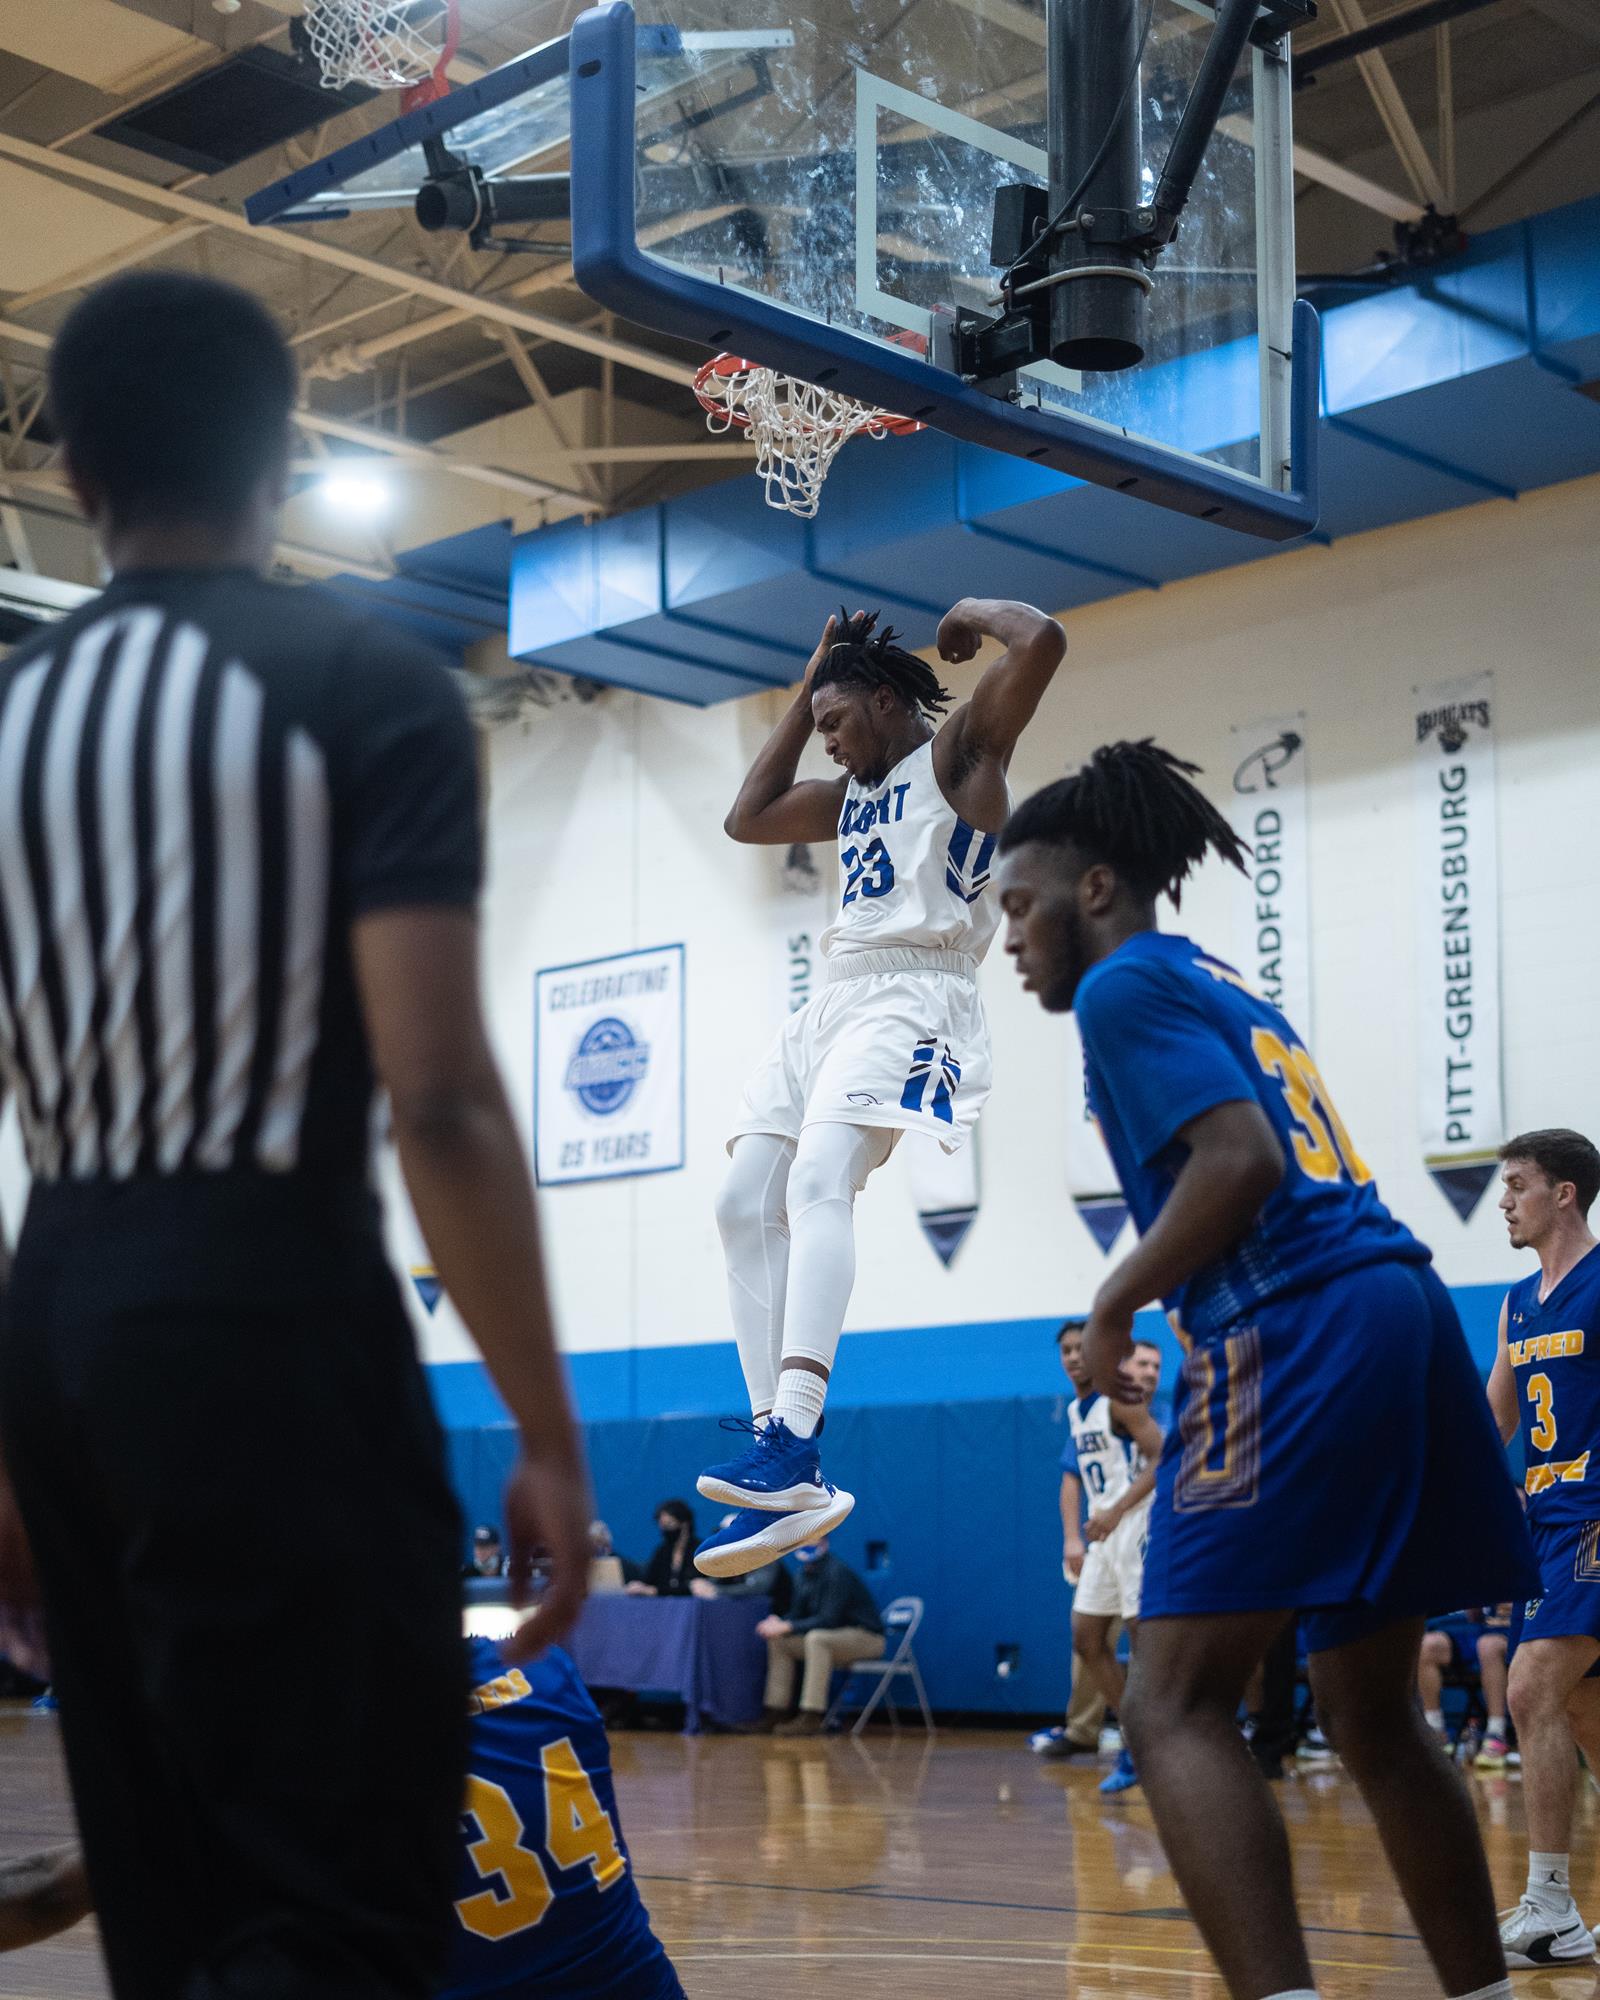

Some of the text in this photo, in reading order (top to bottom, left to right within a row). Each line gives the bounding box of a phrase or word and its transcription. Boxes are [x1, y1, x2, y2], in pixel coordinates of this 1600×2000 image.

[1416, 699, 1490, 743] BOBCATS
[841, 837, 895, 910] 23
[549, 964, 670, 1011] CELEBRATING
[1439, 765, 1473, 1145] PITT-GREENSBURG
[592, 1131, 652, 1163] YEARS
[1526, 1372, 1558, 1452] 3
[453, 1736, 626, 1942] 34
